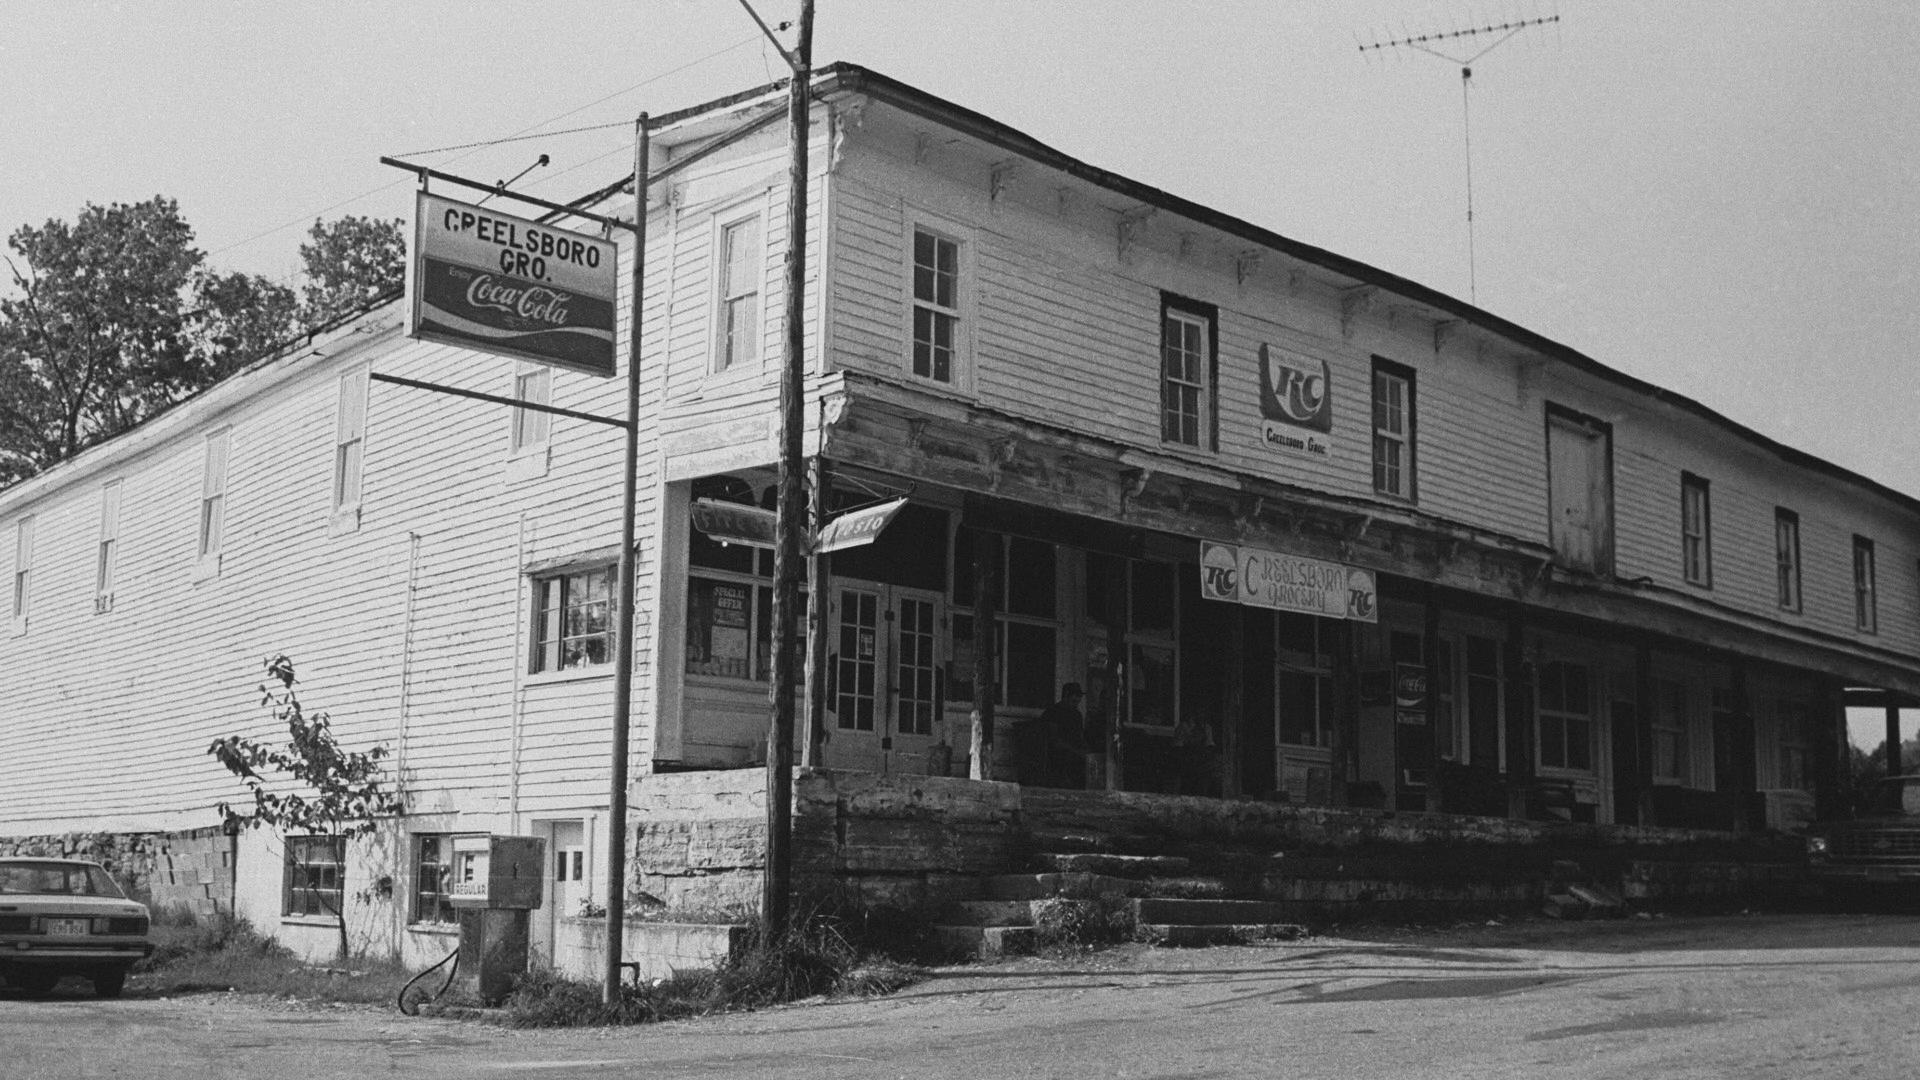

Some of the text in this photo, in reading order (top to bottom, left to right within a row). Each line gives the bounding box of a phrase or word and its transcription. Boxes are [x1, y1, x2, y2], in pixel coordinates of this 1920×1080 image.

[1275, 365, 1325, 419] RC
[1204, 564, 1237, 596] RC
[718, 598, 742, 610] OFFER
[1348, 588, 1374, 617] RC
[455, 884, 486, 896] REGULAR
